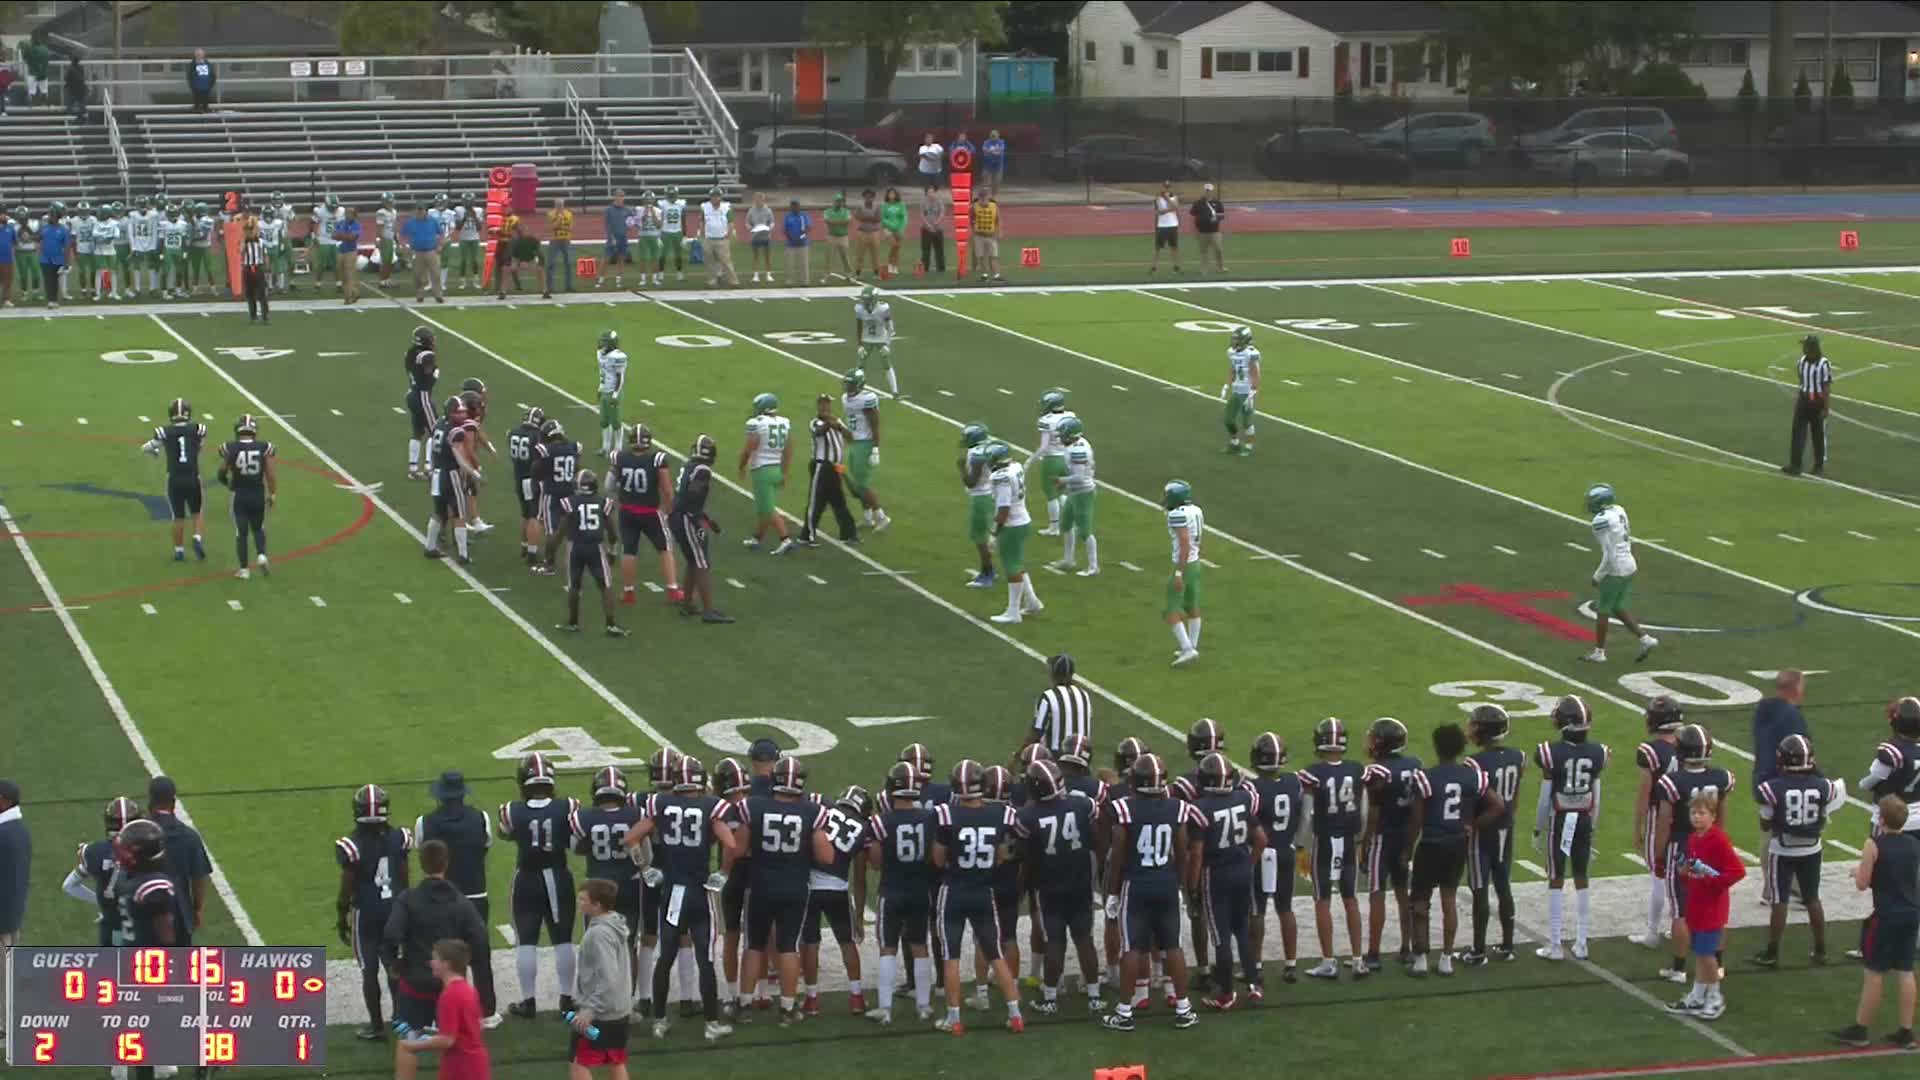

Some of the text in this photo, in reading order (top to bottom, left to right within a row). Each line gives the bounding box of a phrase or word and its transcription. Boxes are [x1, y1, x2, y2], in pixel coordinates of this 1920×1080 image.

[579, 259, 596, 274] 30
[1023, 250, 1038, 264] 20
[175, 436, 189, 463] 1
[235, 451, 261, 475] 45
[510, 436, 530, 460] 66
[553, 456, 575, 482] 50
[621, 468, 648, 493] 70
[577, 503, 600, 530] 15
[1495, 765, 1518, 802] 10
[1563, 758, 1593, 793] 16
[1272, 793, 1290, 832] 9
[1326, 775, 1357, 814] 14
[1443, 783, 1462, 820] 2
[1784, 789, 1821, 826] 86
[528, 818, 553, 852] 11
[591, 823, 631, 861] 83
[662, 805, 703, 848] 33
[761, 812, 802, 852] 53
[895, 823, 925, 863] 61
[1038, 811, 1083, 856] 74
[1136, 823, 1172, 867] 40
[1213, 804, 1248, 849] 75
[958, 827, 997, 869] 35
[373, 855, 394, 899] 4
